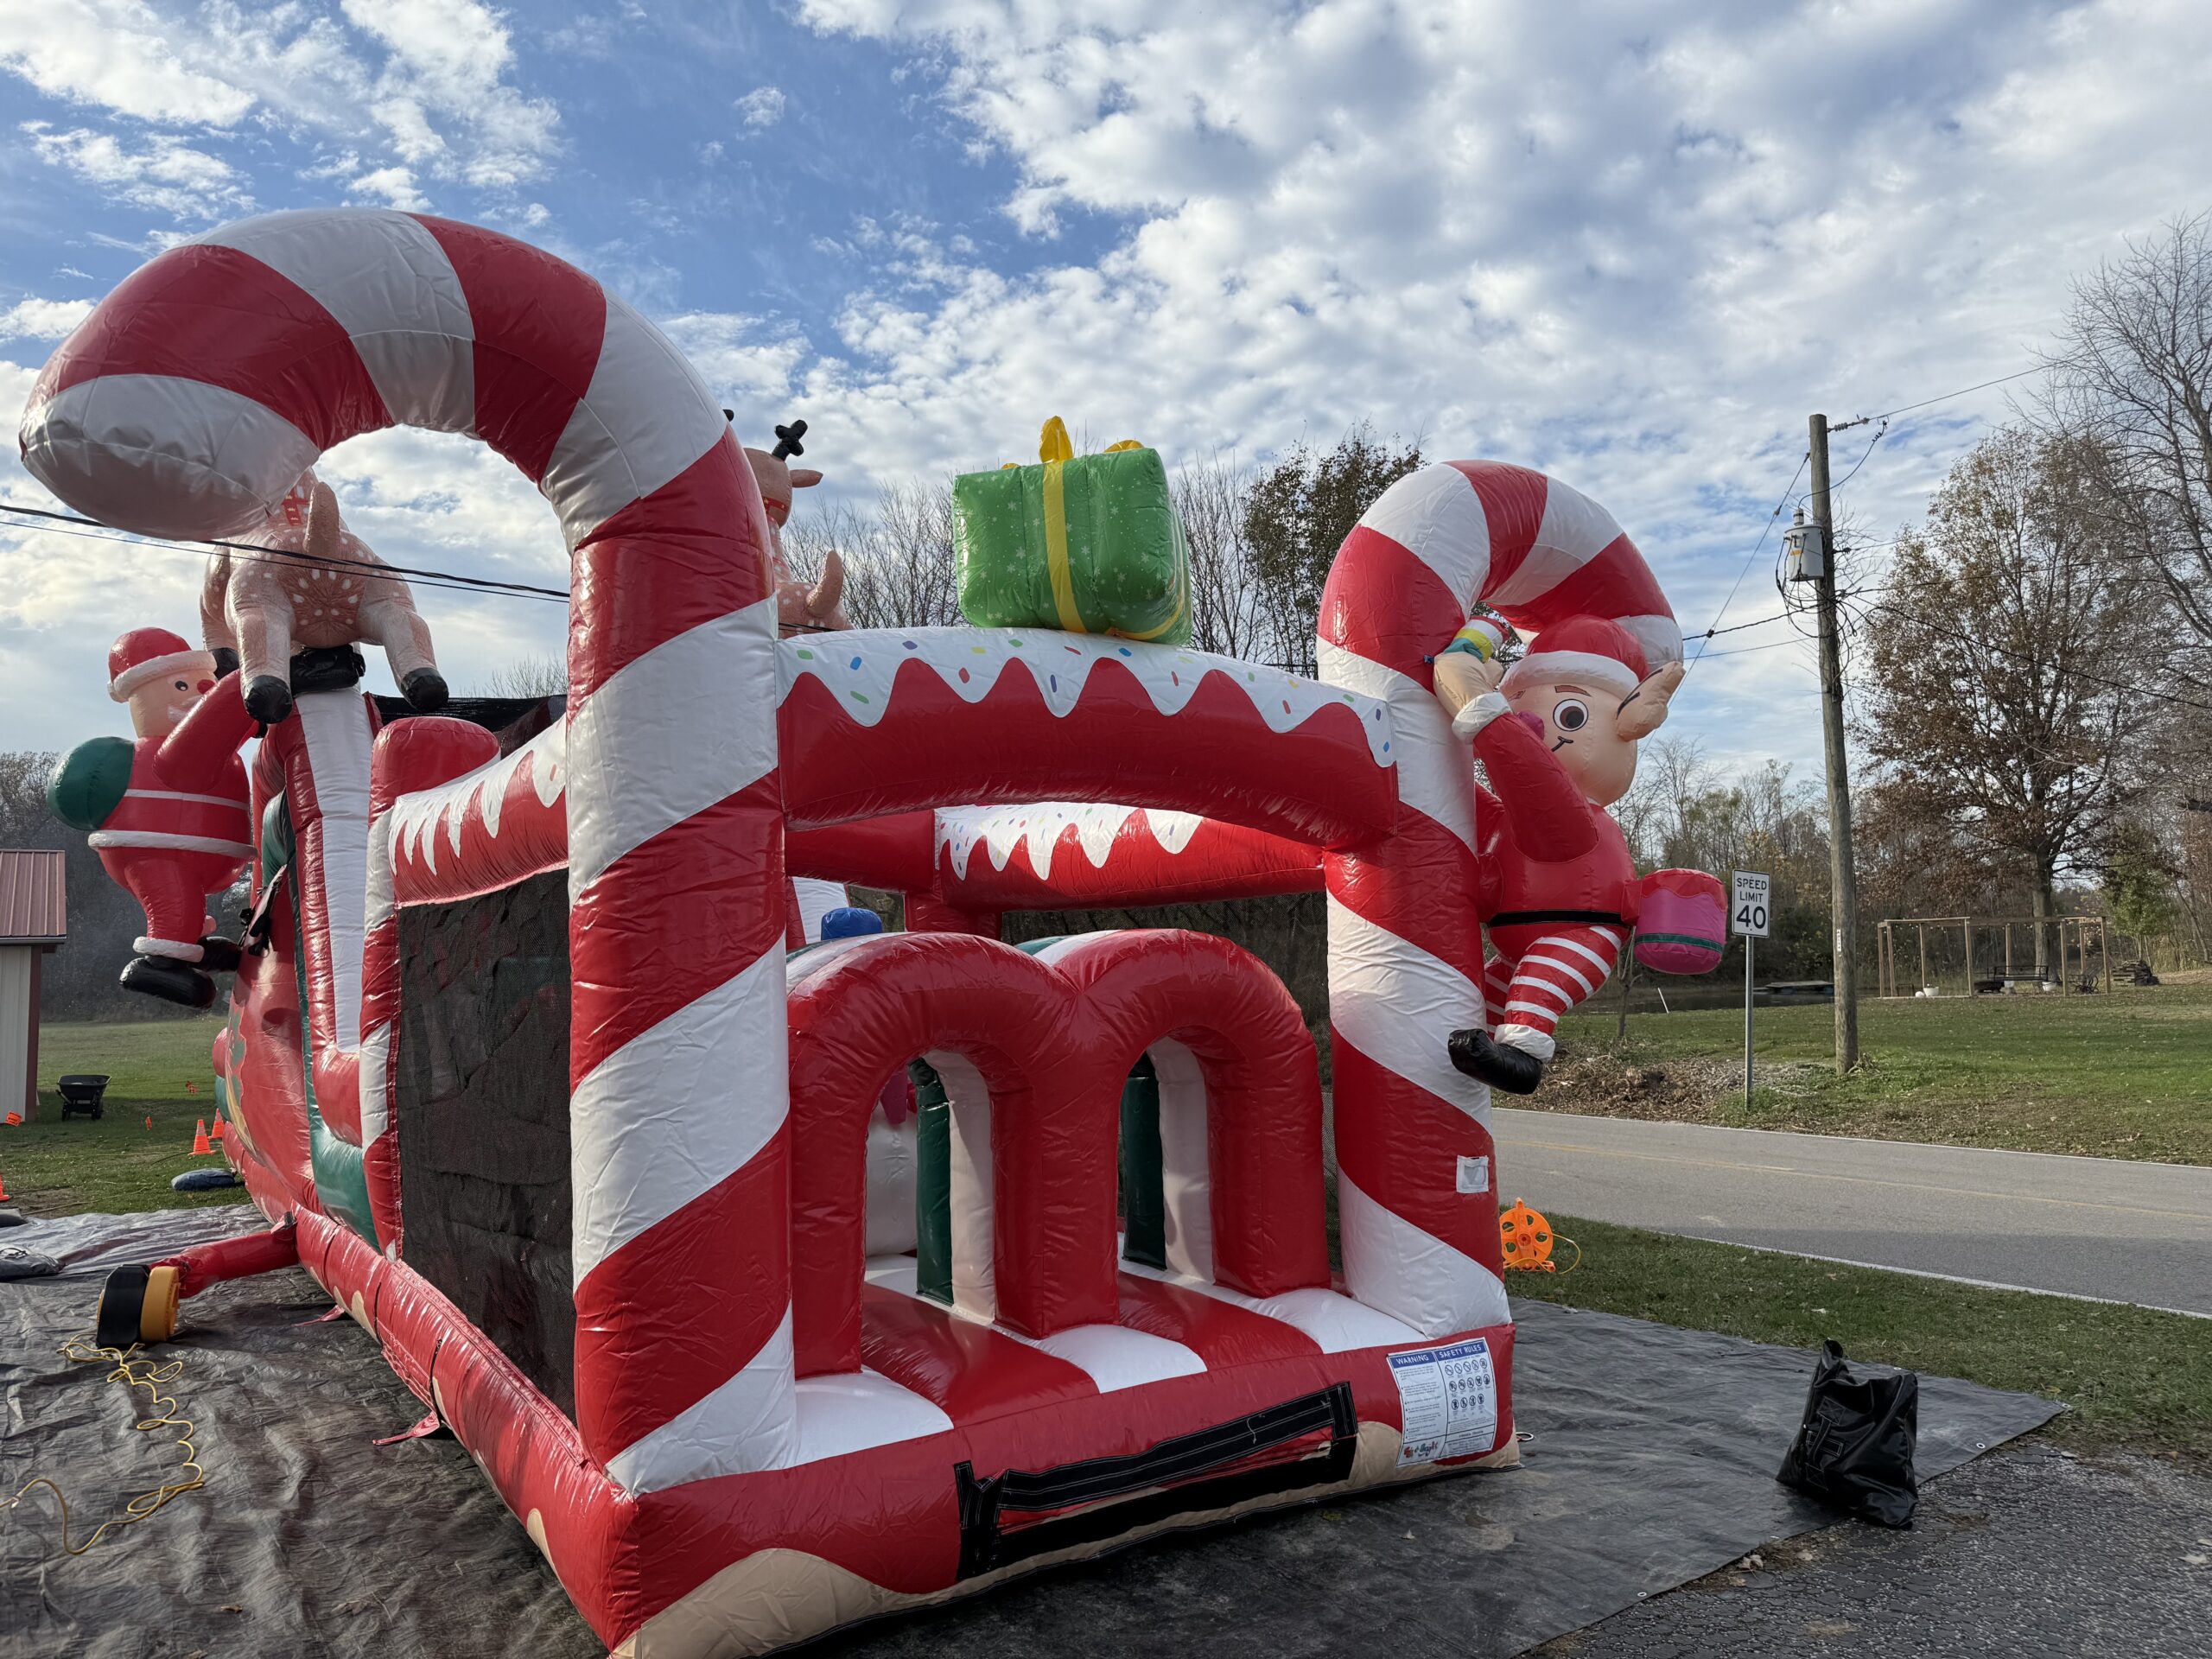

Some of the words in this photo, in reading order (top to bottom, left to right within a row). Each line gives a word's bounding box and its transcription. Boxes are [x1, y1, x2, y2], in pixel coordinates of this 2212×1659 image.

[1737, 878, 1767, 890] SPEED
[1739, 891, 1763, 902] LIMIT
[1736, 905, 1766, 929] 40
[1439, 1348, 1463, 1358] SAFETY
[1464, 1344, 1482, 1353] RULES
[1396, 1354, 1429, 1364] WARNING
